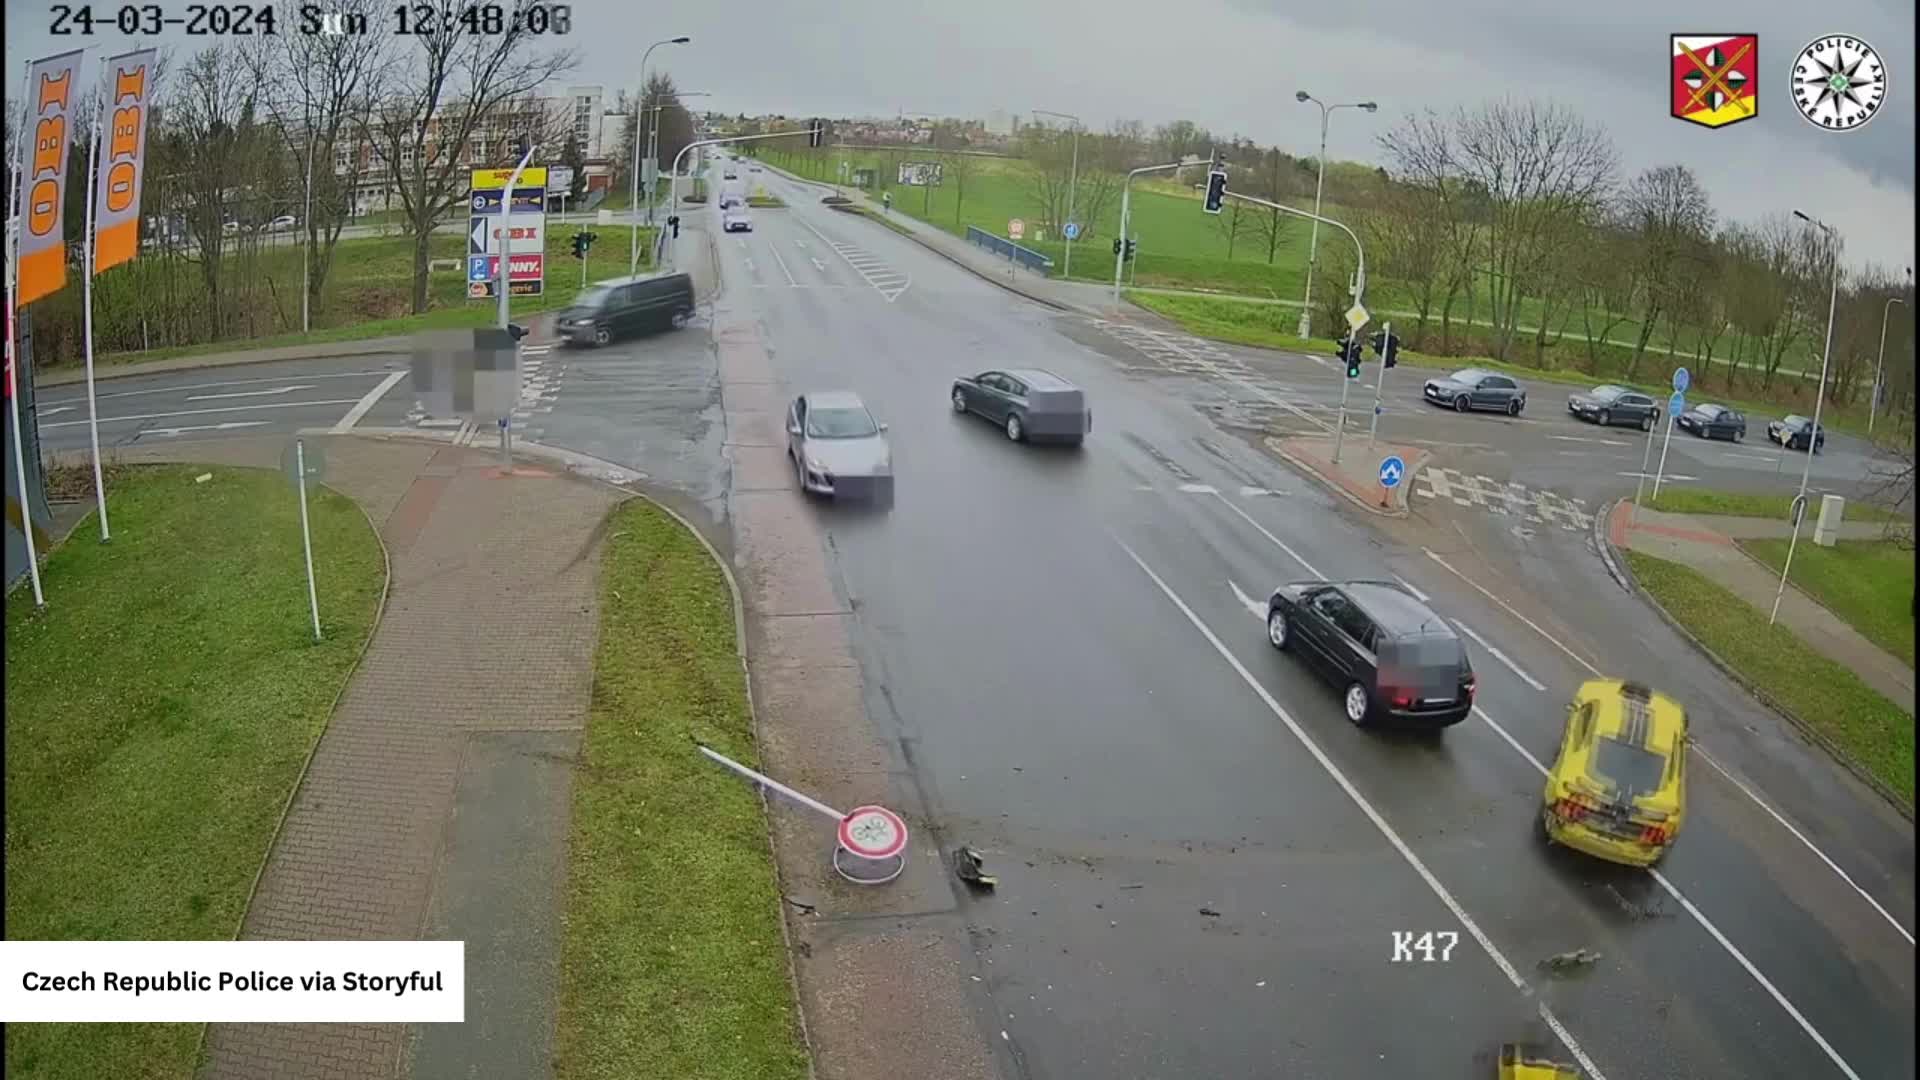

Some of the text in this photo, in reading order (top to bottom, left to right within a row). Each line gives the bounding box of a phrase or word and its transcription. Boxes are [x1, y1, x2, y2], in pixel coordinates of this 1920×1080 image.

[29, 68, 71, 236] OBI
[106, 64, 146, 213] OBI
[493, 261, 540, 273] PNNY.
